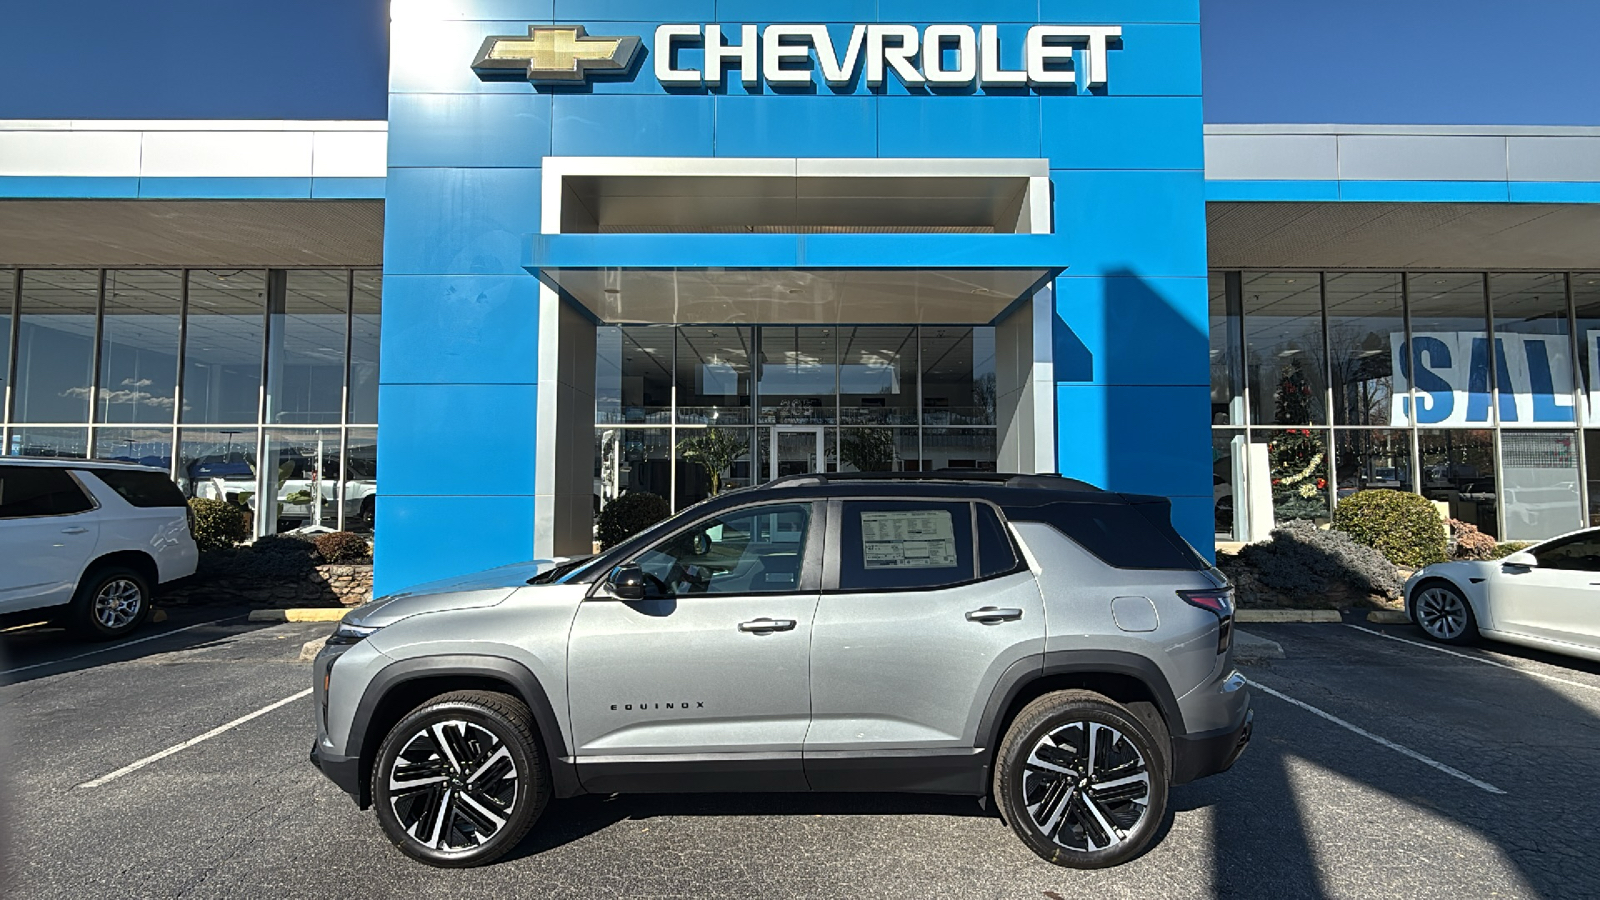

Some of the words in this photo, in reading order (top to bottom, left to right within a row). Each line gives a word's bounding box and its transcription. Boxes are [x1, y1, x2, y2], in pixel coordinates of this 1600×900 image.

[654, 24, 1122, 86] CHEVROLET
[1399, 335, 1600, 424] SAL
[610, 701, 704, 711] EQUINOX
